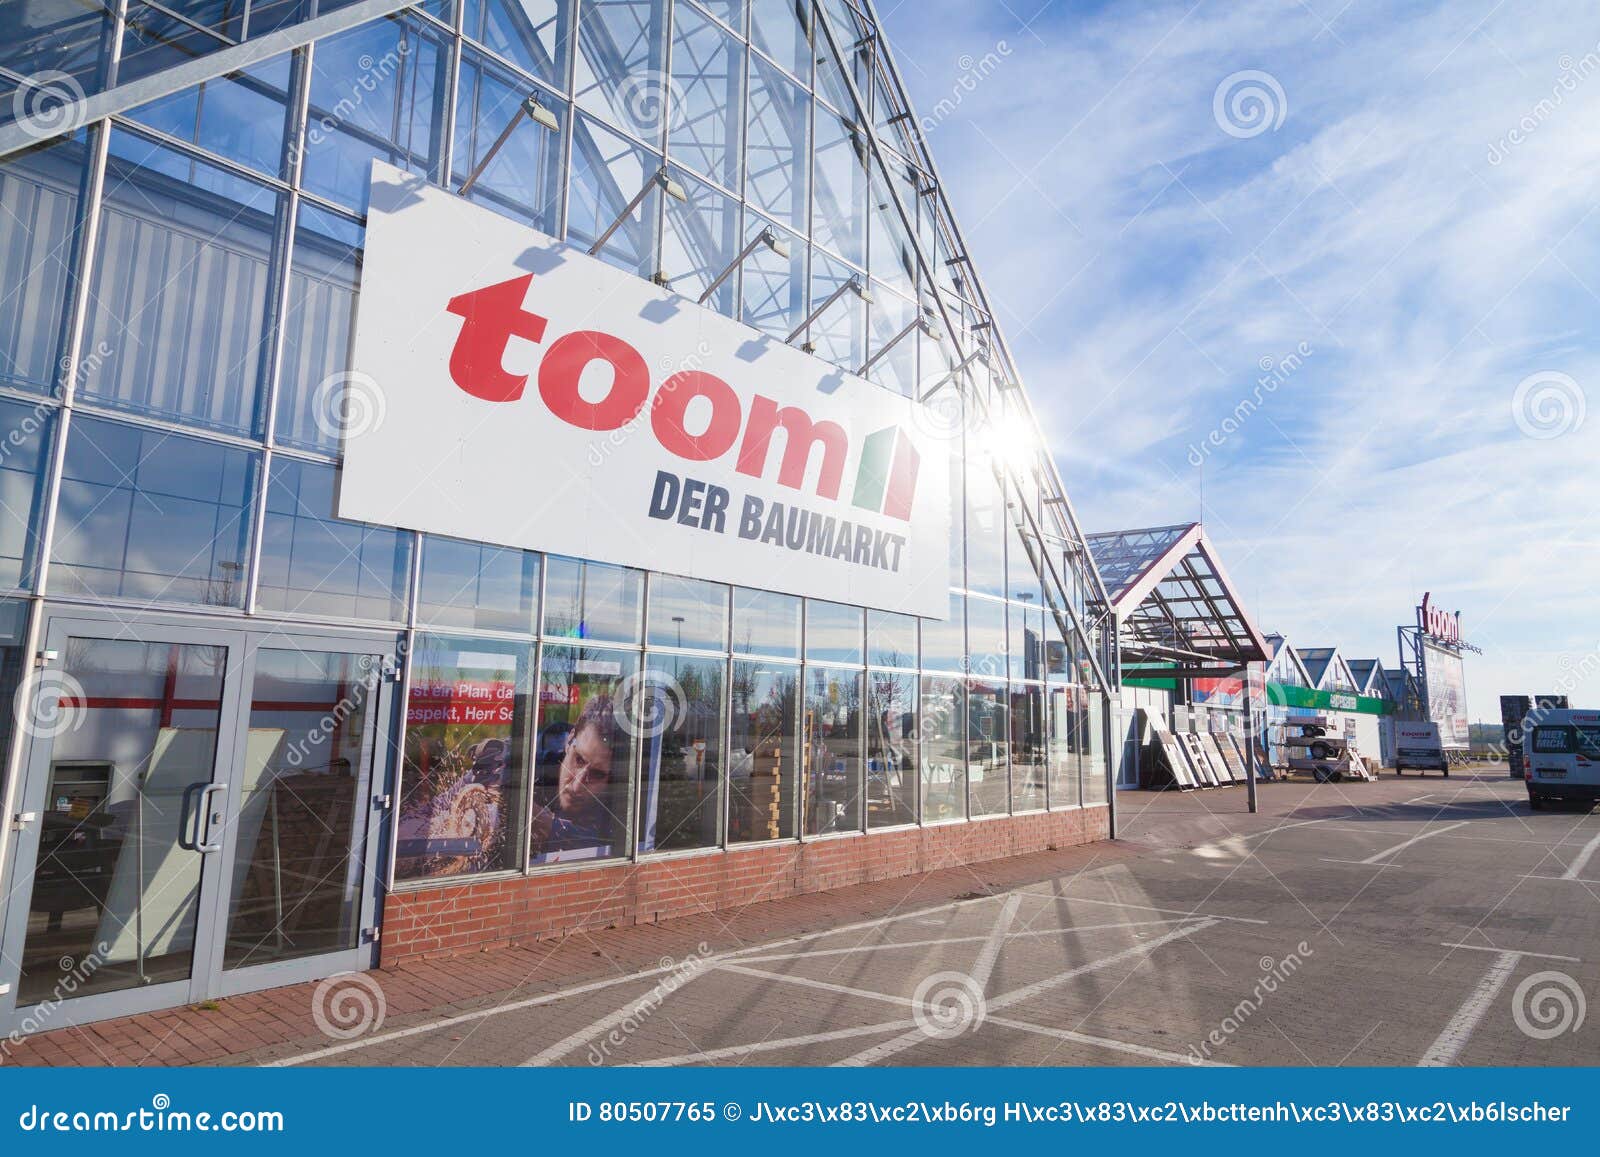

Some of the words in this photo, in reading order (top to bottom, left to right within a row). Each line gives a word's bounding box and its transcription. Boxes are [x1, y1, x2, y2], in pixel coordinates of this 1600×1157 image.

[446, 272, 849, 500] toom
[648, 470, 730, 534] DER
[738, 494, 906, 573] BAUMARKT
[407, 706, 461, 722] espekt,
[465, 707, 496, 721] Herr
[408, 684, 429, 697] st
[432, 685, 454, 697] ein
[458, 683, 493, 701] Plan,
